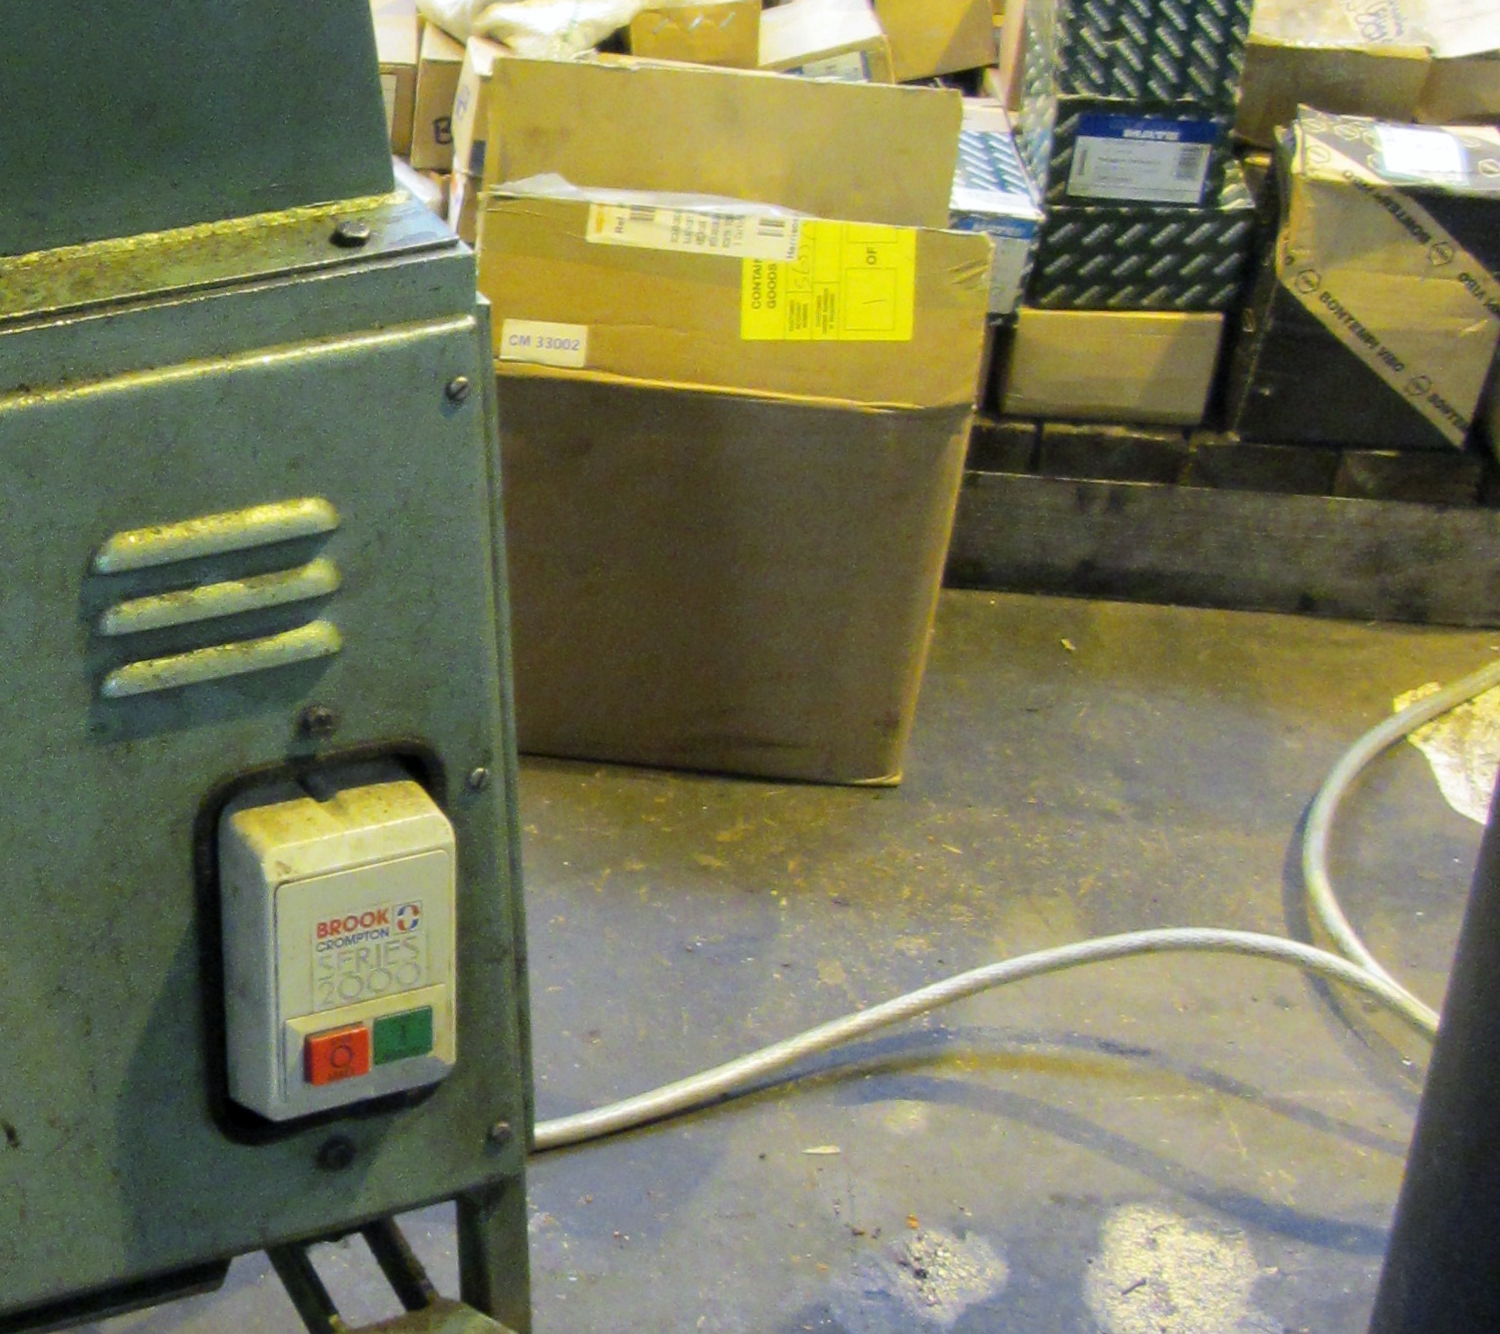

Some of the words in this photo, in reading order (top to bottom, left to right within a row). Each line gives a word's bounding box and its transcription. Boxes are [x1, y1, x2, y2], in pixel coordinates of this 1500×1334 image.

[866, 246, 878, 266] OF
[766, 263, 777, 310] GOODS
[509, 334, 531, 347] CM
[536, 335, 580, 351] 33002
[316, 908, 390, 939] BROOK
[316, 927, 390, 953] CROMPTON
[318, 935, 420, 982] SERIES
[318, 961, 421, 1005] 2000
